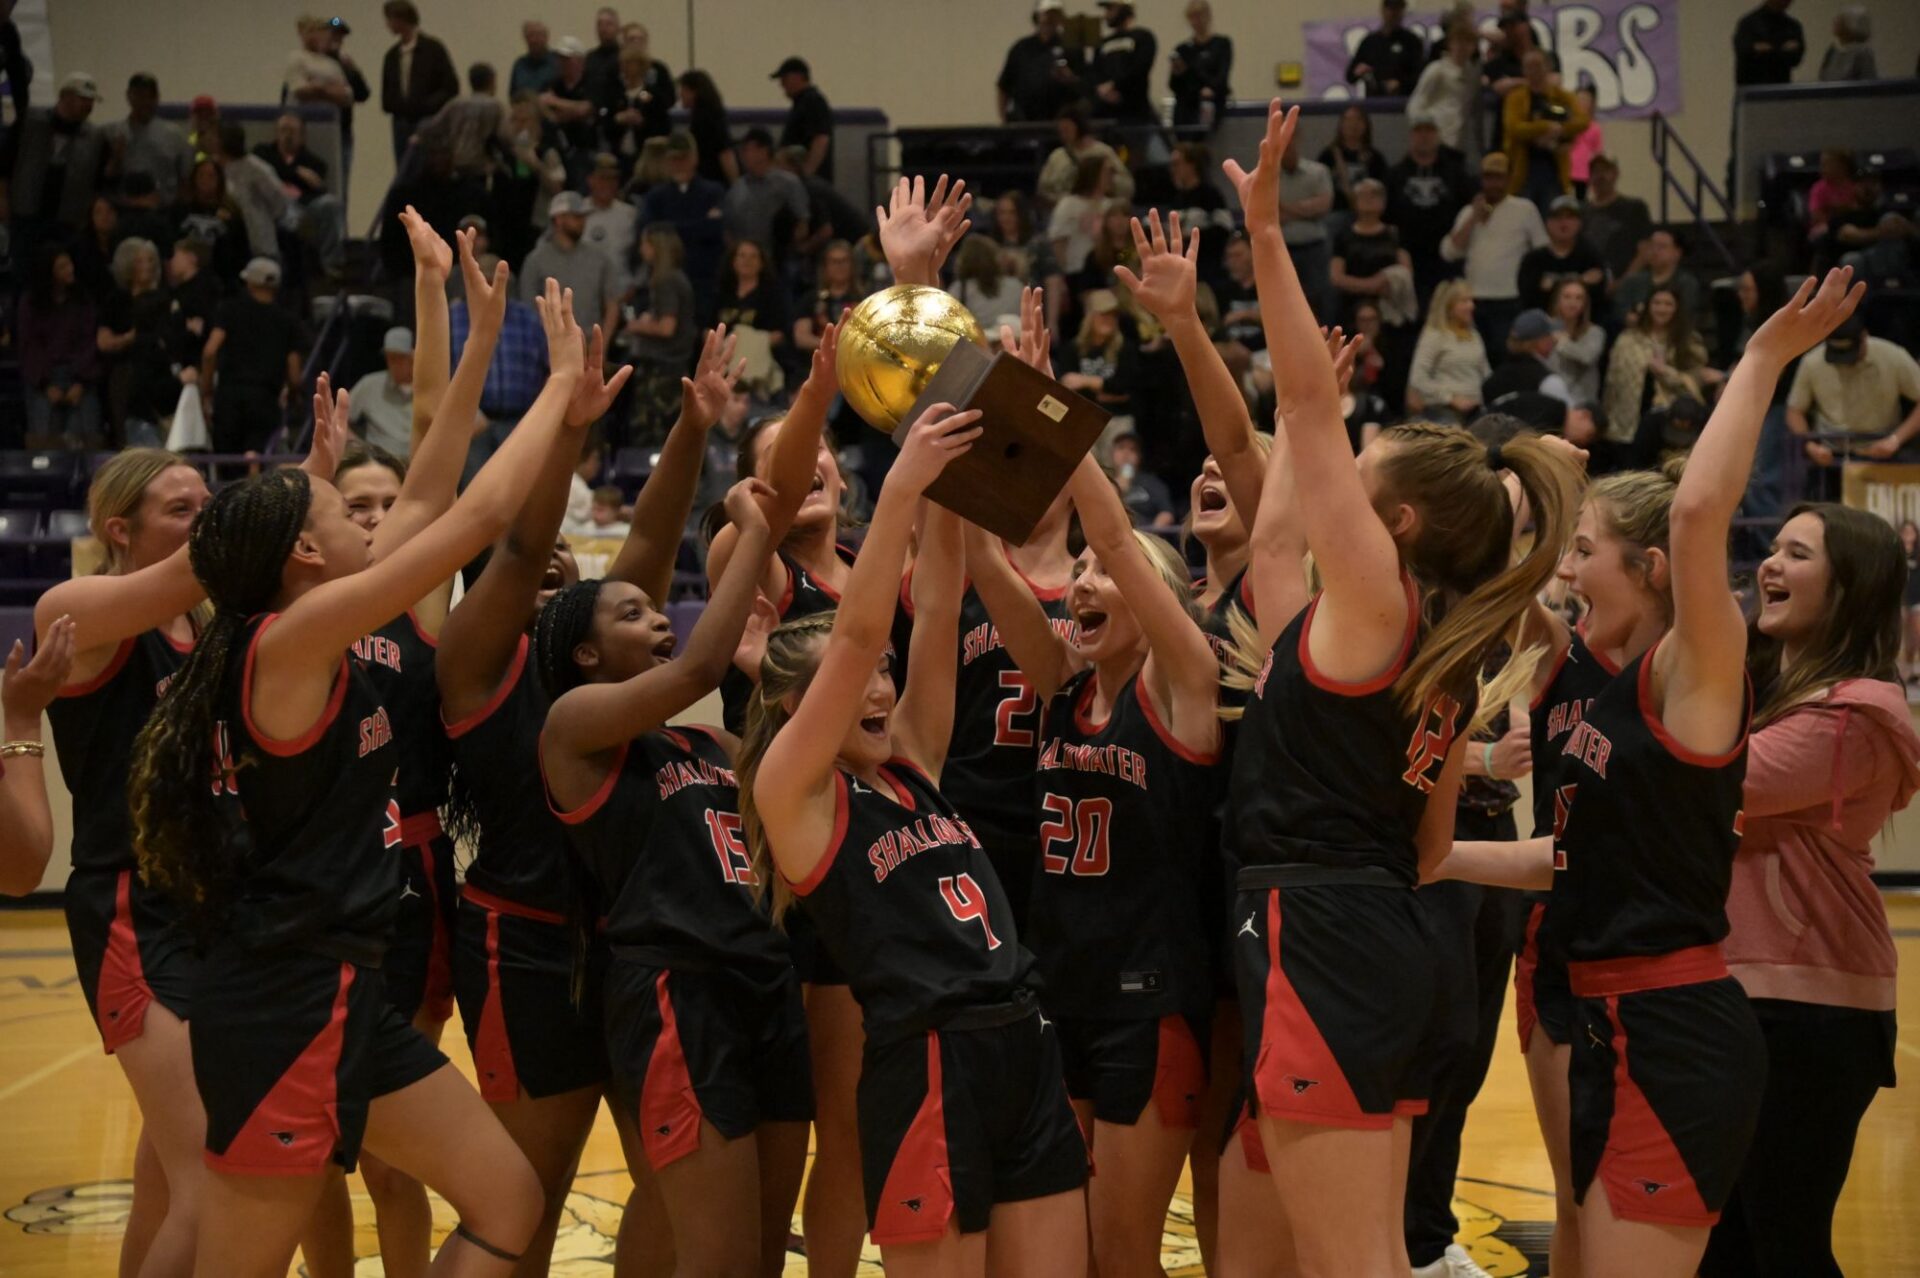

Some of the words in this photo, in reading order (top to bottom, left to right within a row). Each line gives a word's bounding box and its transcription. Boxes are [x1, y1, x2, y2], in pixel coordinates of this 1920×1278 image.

[704, 807, 760, 886] 15
[1039, 792, 1113, 877] 20
[938, 871, 1002, 951] 4
